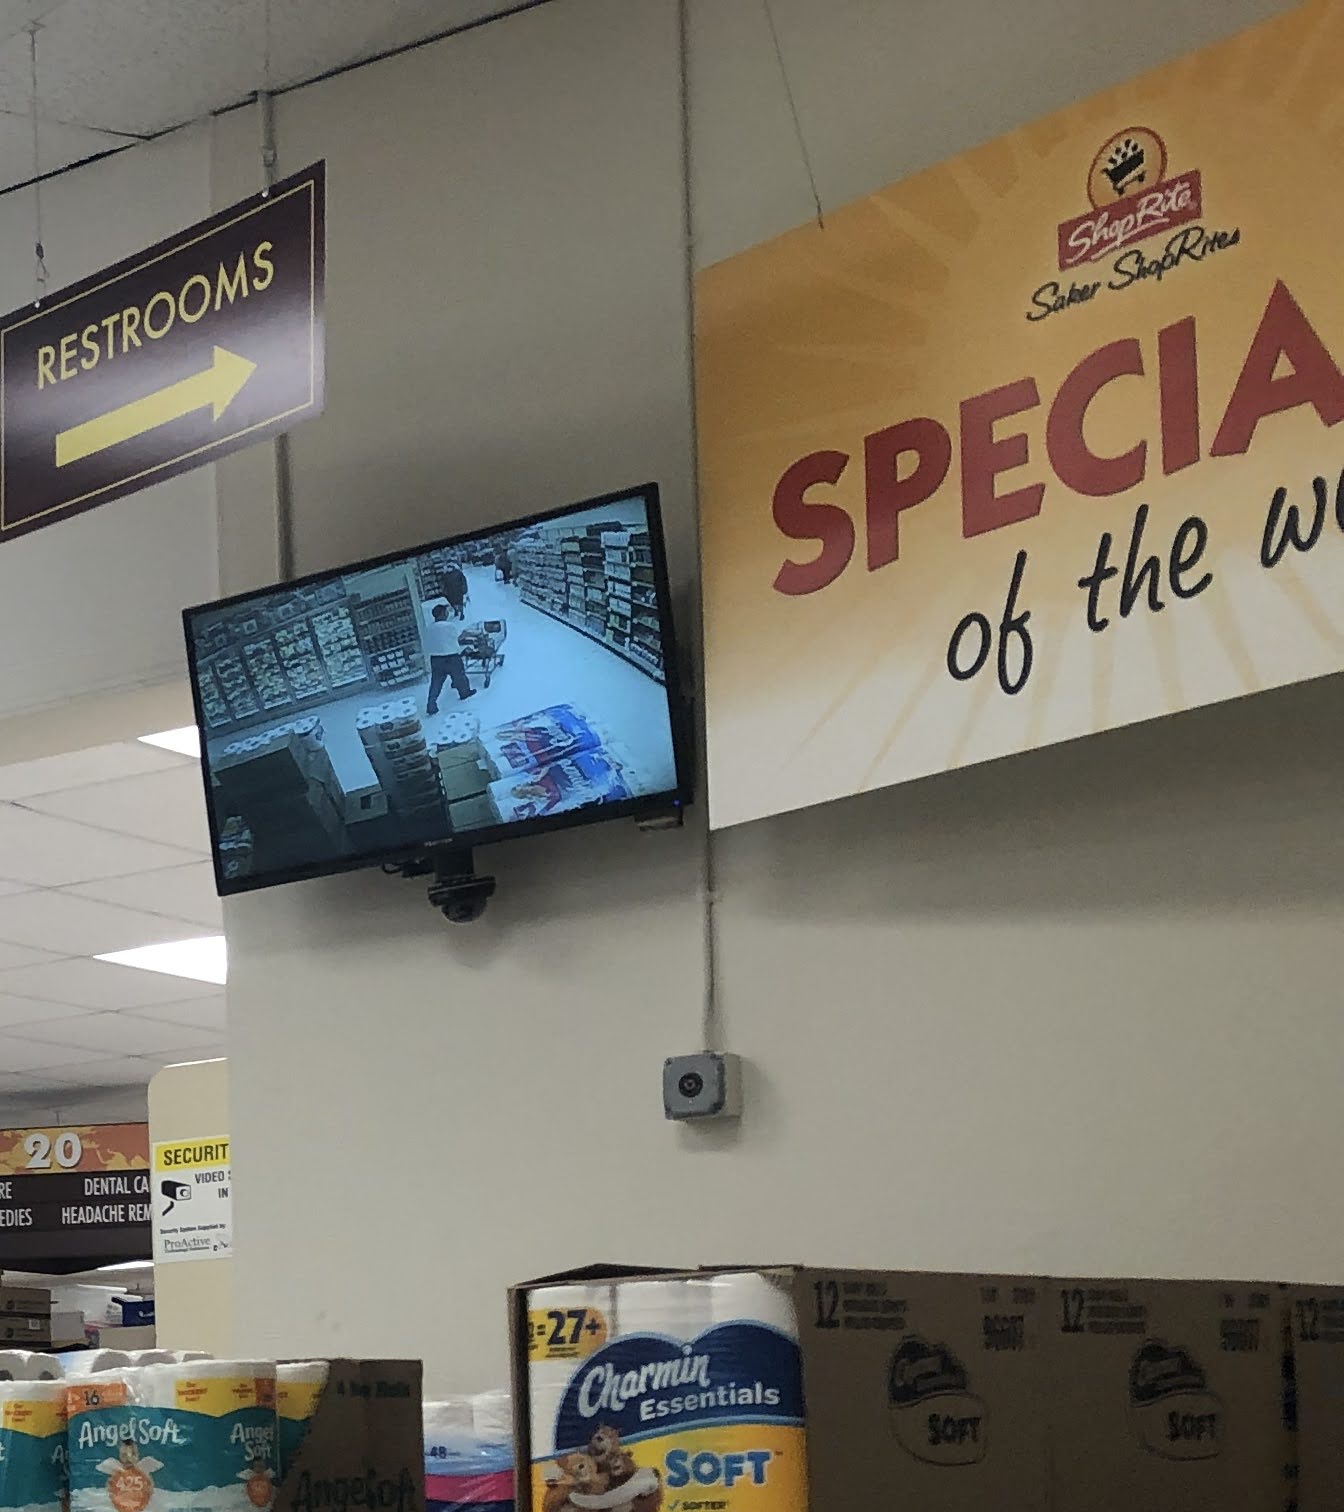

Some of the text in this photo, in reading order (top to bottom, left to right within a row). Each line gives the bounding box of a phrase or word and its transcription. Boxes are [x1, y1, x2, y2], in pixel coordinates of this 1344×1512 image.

[1067, 183, 1193, 262] ShopRite
[36, 241, 275, 391] RESTROOMS
[946, 550, 1033, 695] of
[1078, 505, 1212, 632] the
[24, 1132, 81, 1169] 20
[163, 1144, 229, 1166] SECURIT
[84, 1176, 132, 1196] DENTAL
[195, 1171, 224, 1184] VIDEO
[218, 1188, 228, 1198] IN
[62, 1204, 124, 1225] HEADACHE
[577, 1346, 711, 1418] Charmin
[640, 1381, 780, 1422] Essentials
[928, 1413, 982, 1445] SOFT
[115, 1476, 143, 1492] 425
[665, 1449, 770, 1489] SOFT
